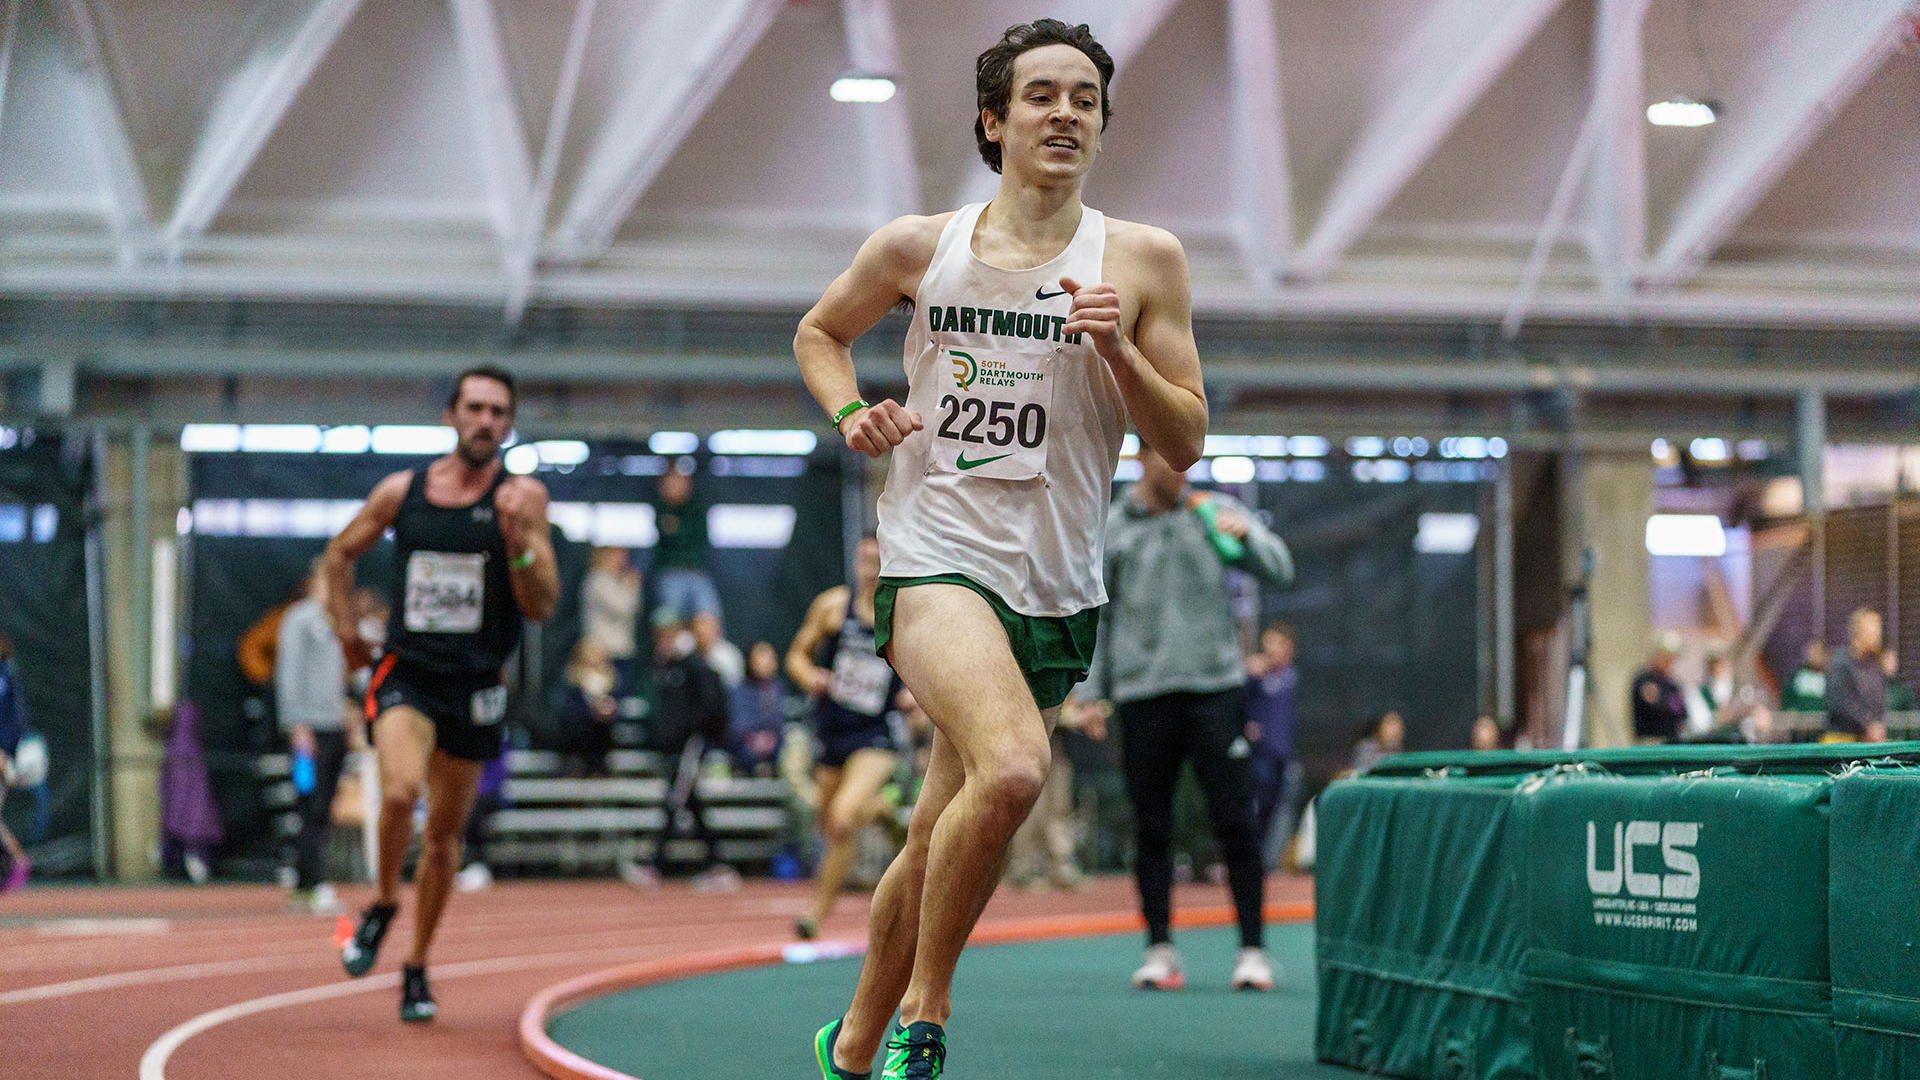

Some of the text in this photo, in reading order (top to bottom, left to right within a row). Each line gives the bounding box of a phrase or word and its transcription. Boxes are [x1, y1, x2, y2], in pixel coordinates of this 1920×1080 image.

[981, 360, 1006, 369] 50TH
[980, 368, 1044, 381] DARTMOUTH
[979, 377, 1016, 387] RELAYS
[937, 394, 1046, 448] 2250
[1586, 820, 1701, 900] UCS
